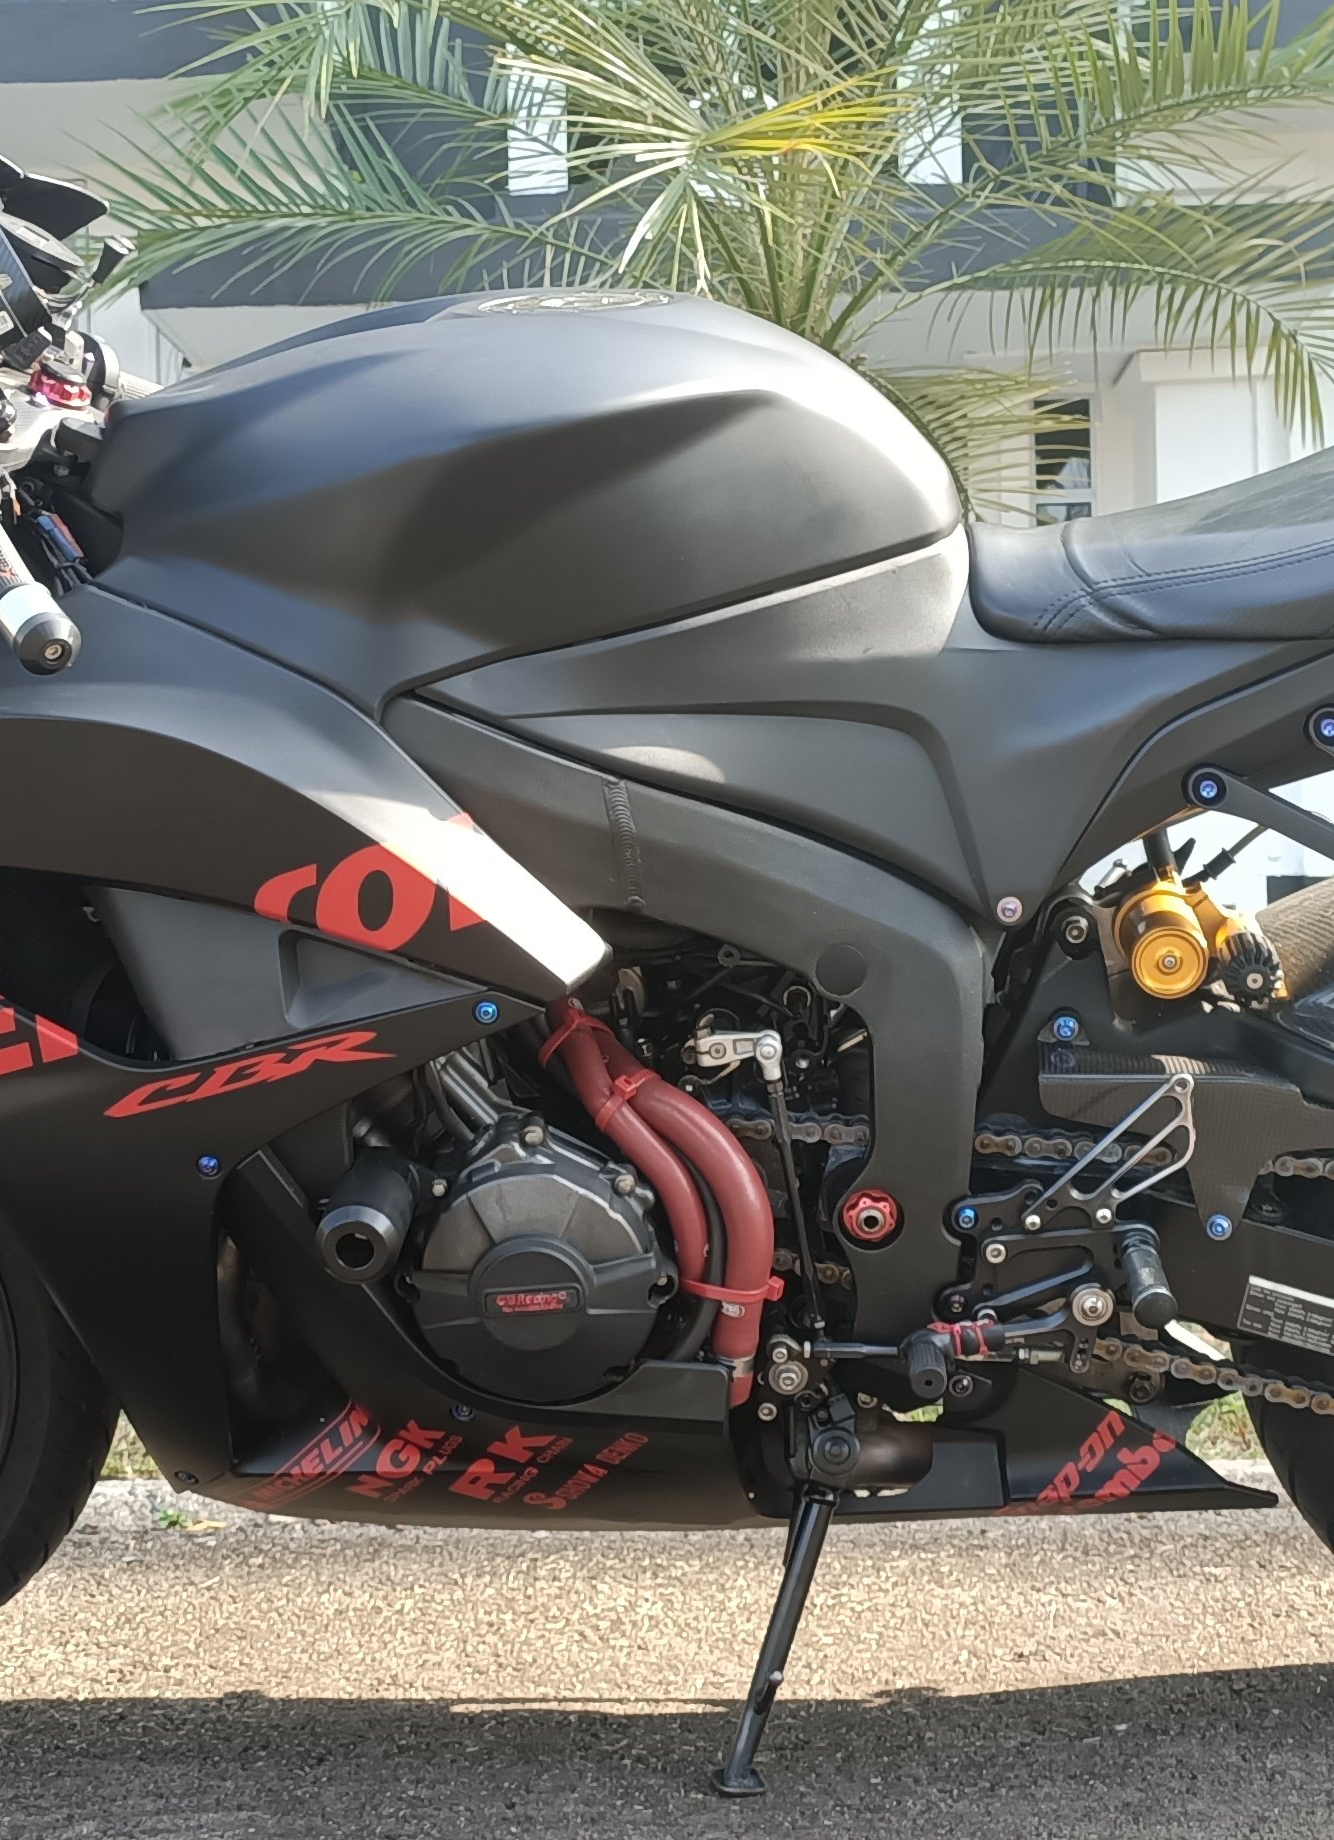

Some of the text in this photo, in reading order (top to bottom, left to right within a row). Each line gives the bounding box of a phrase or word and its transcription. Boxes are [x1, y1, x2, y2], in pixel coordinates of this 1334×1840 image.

[103, 1031, 397, 1118] CBR
[253, 1403, 370, 1499] MICHELIN
[346, 1419, 446, 1499] NGK
[448, 1426, 557, 1500] RK
